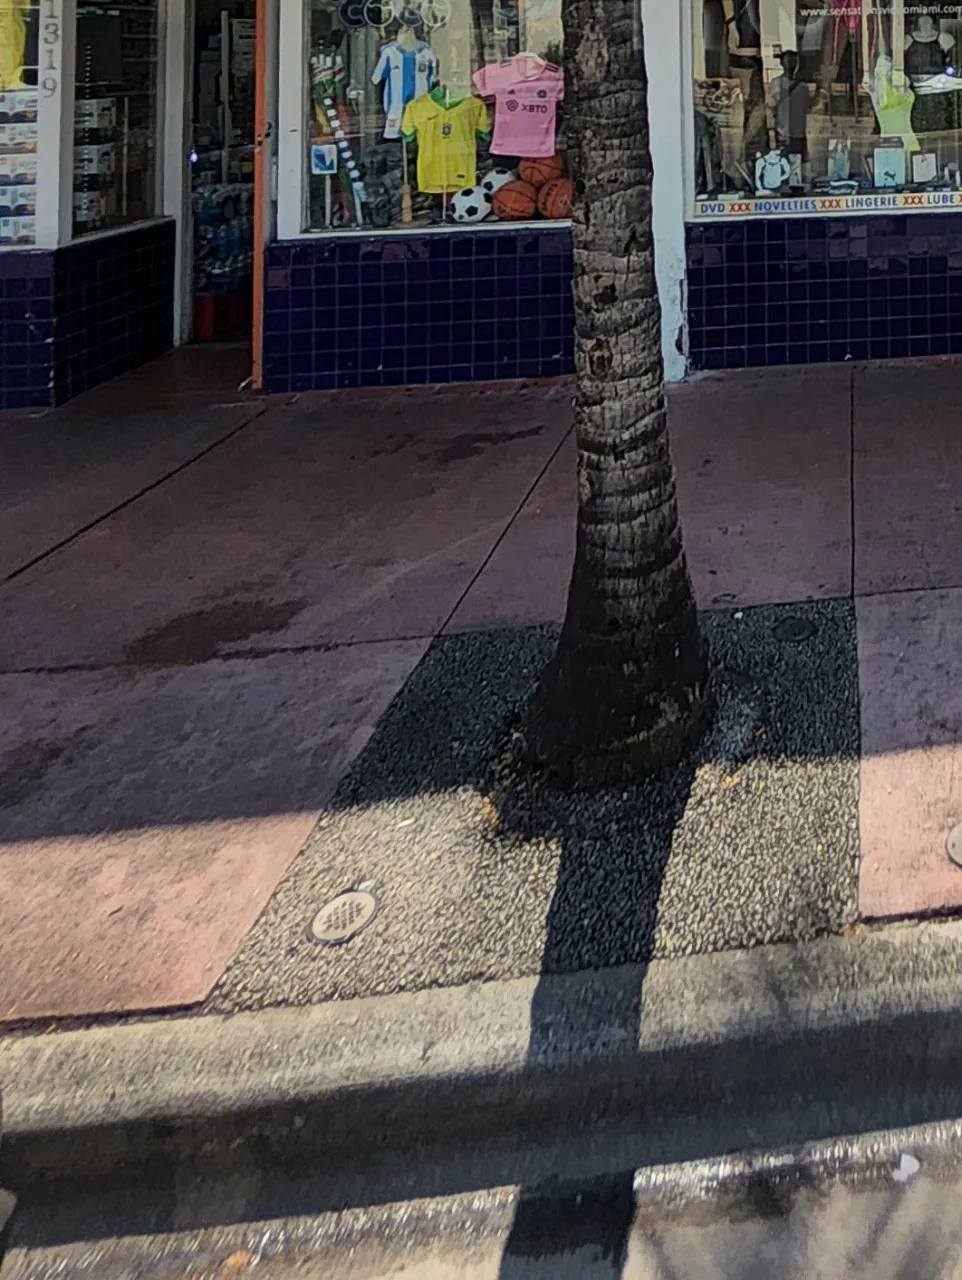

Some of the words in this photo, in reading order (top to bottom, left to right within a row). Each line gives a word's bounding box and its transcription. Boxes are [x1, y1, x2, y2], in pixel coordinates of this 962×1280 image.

[521, 104, 548, 114] XBTO
[700, 202, 726, 214] DVD
[729, 202, 751, 213] XXX
[754, 199, 817, 212] NOVELTIES
[820, 198, 842, 210] XXX
[845, 195, 898, 208] LINGERIE
[903, 195, 924, 206] XXX
[926, 193, 955, 205] LUBE
